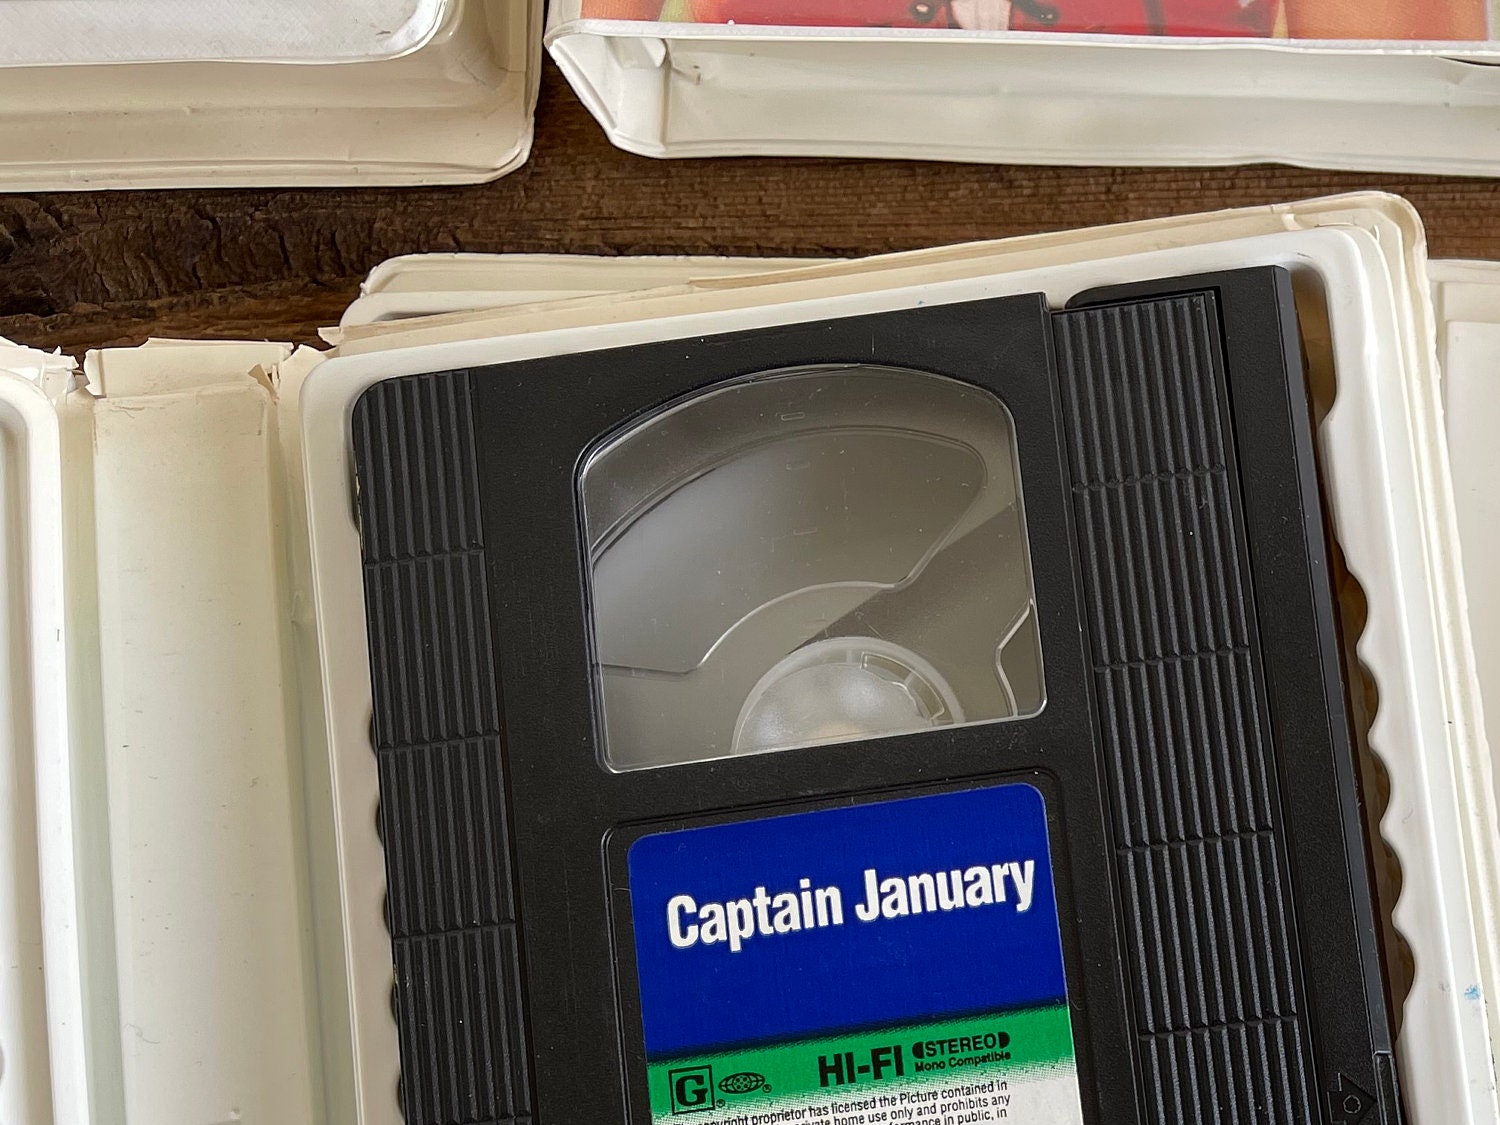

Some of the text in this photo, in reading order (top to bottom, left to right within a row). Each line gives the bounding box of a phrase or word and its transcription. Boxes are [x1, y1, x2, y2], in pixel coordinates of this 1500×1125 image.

[667, 860, 1034, 951] Captain January
[817, 1033, 996, 1087] HI-FI STEREO
[914, 1050, 1011, 1072] Mono Compatible
[674, 1072, 709, 1108] G
